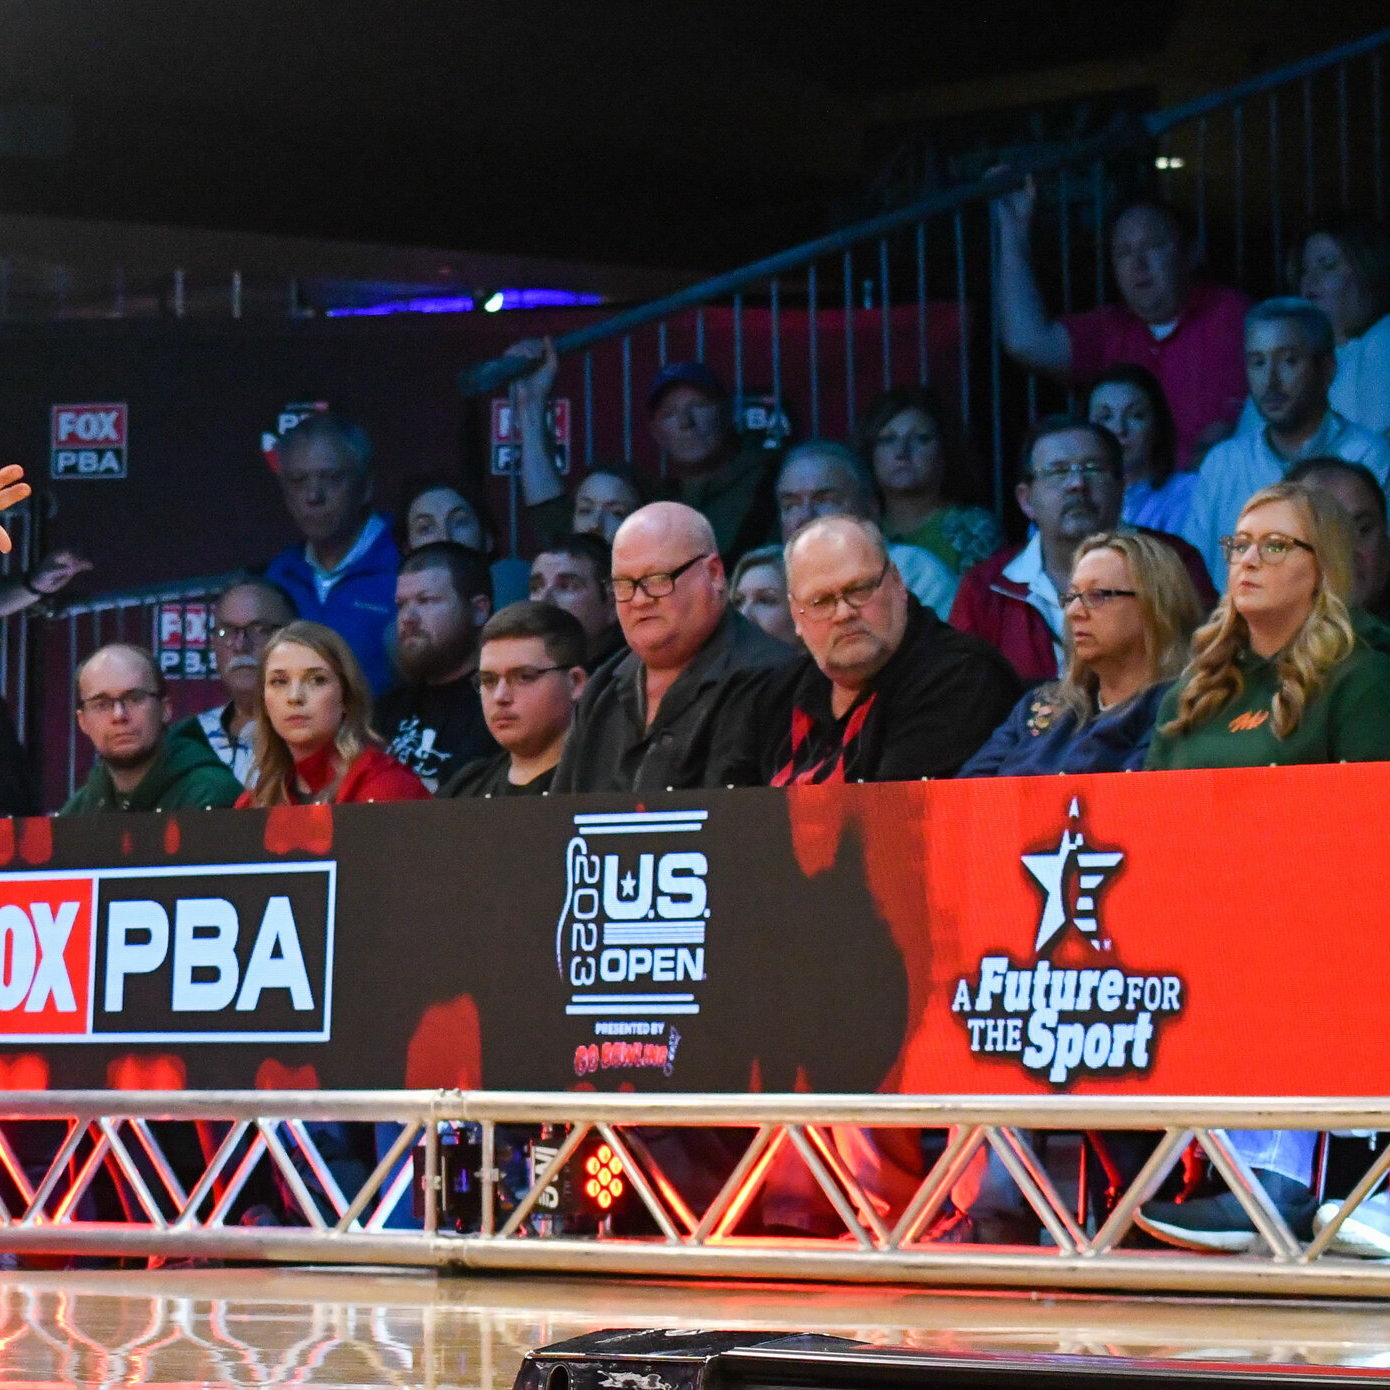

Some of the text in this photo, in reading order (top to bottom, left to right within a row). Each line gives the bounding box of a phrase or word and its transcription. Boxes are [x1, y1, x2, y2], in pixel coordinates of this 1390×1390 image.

[58, 410, 119, 441] FOX
[57, 450, 120, 474] PBA
[603, 852, 711, 920] U.S.
[570, 854, 601, 987] 2023
[104, 896, 315, 1012] PBA
[600, 947, 706, 982] OPEN
[951, 956, 1182, 1013] A Future FOR
[967, 1010, 1154, 1083] THE Sport
